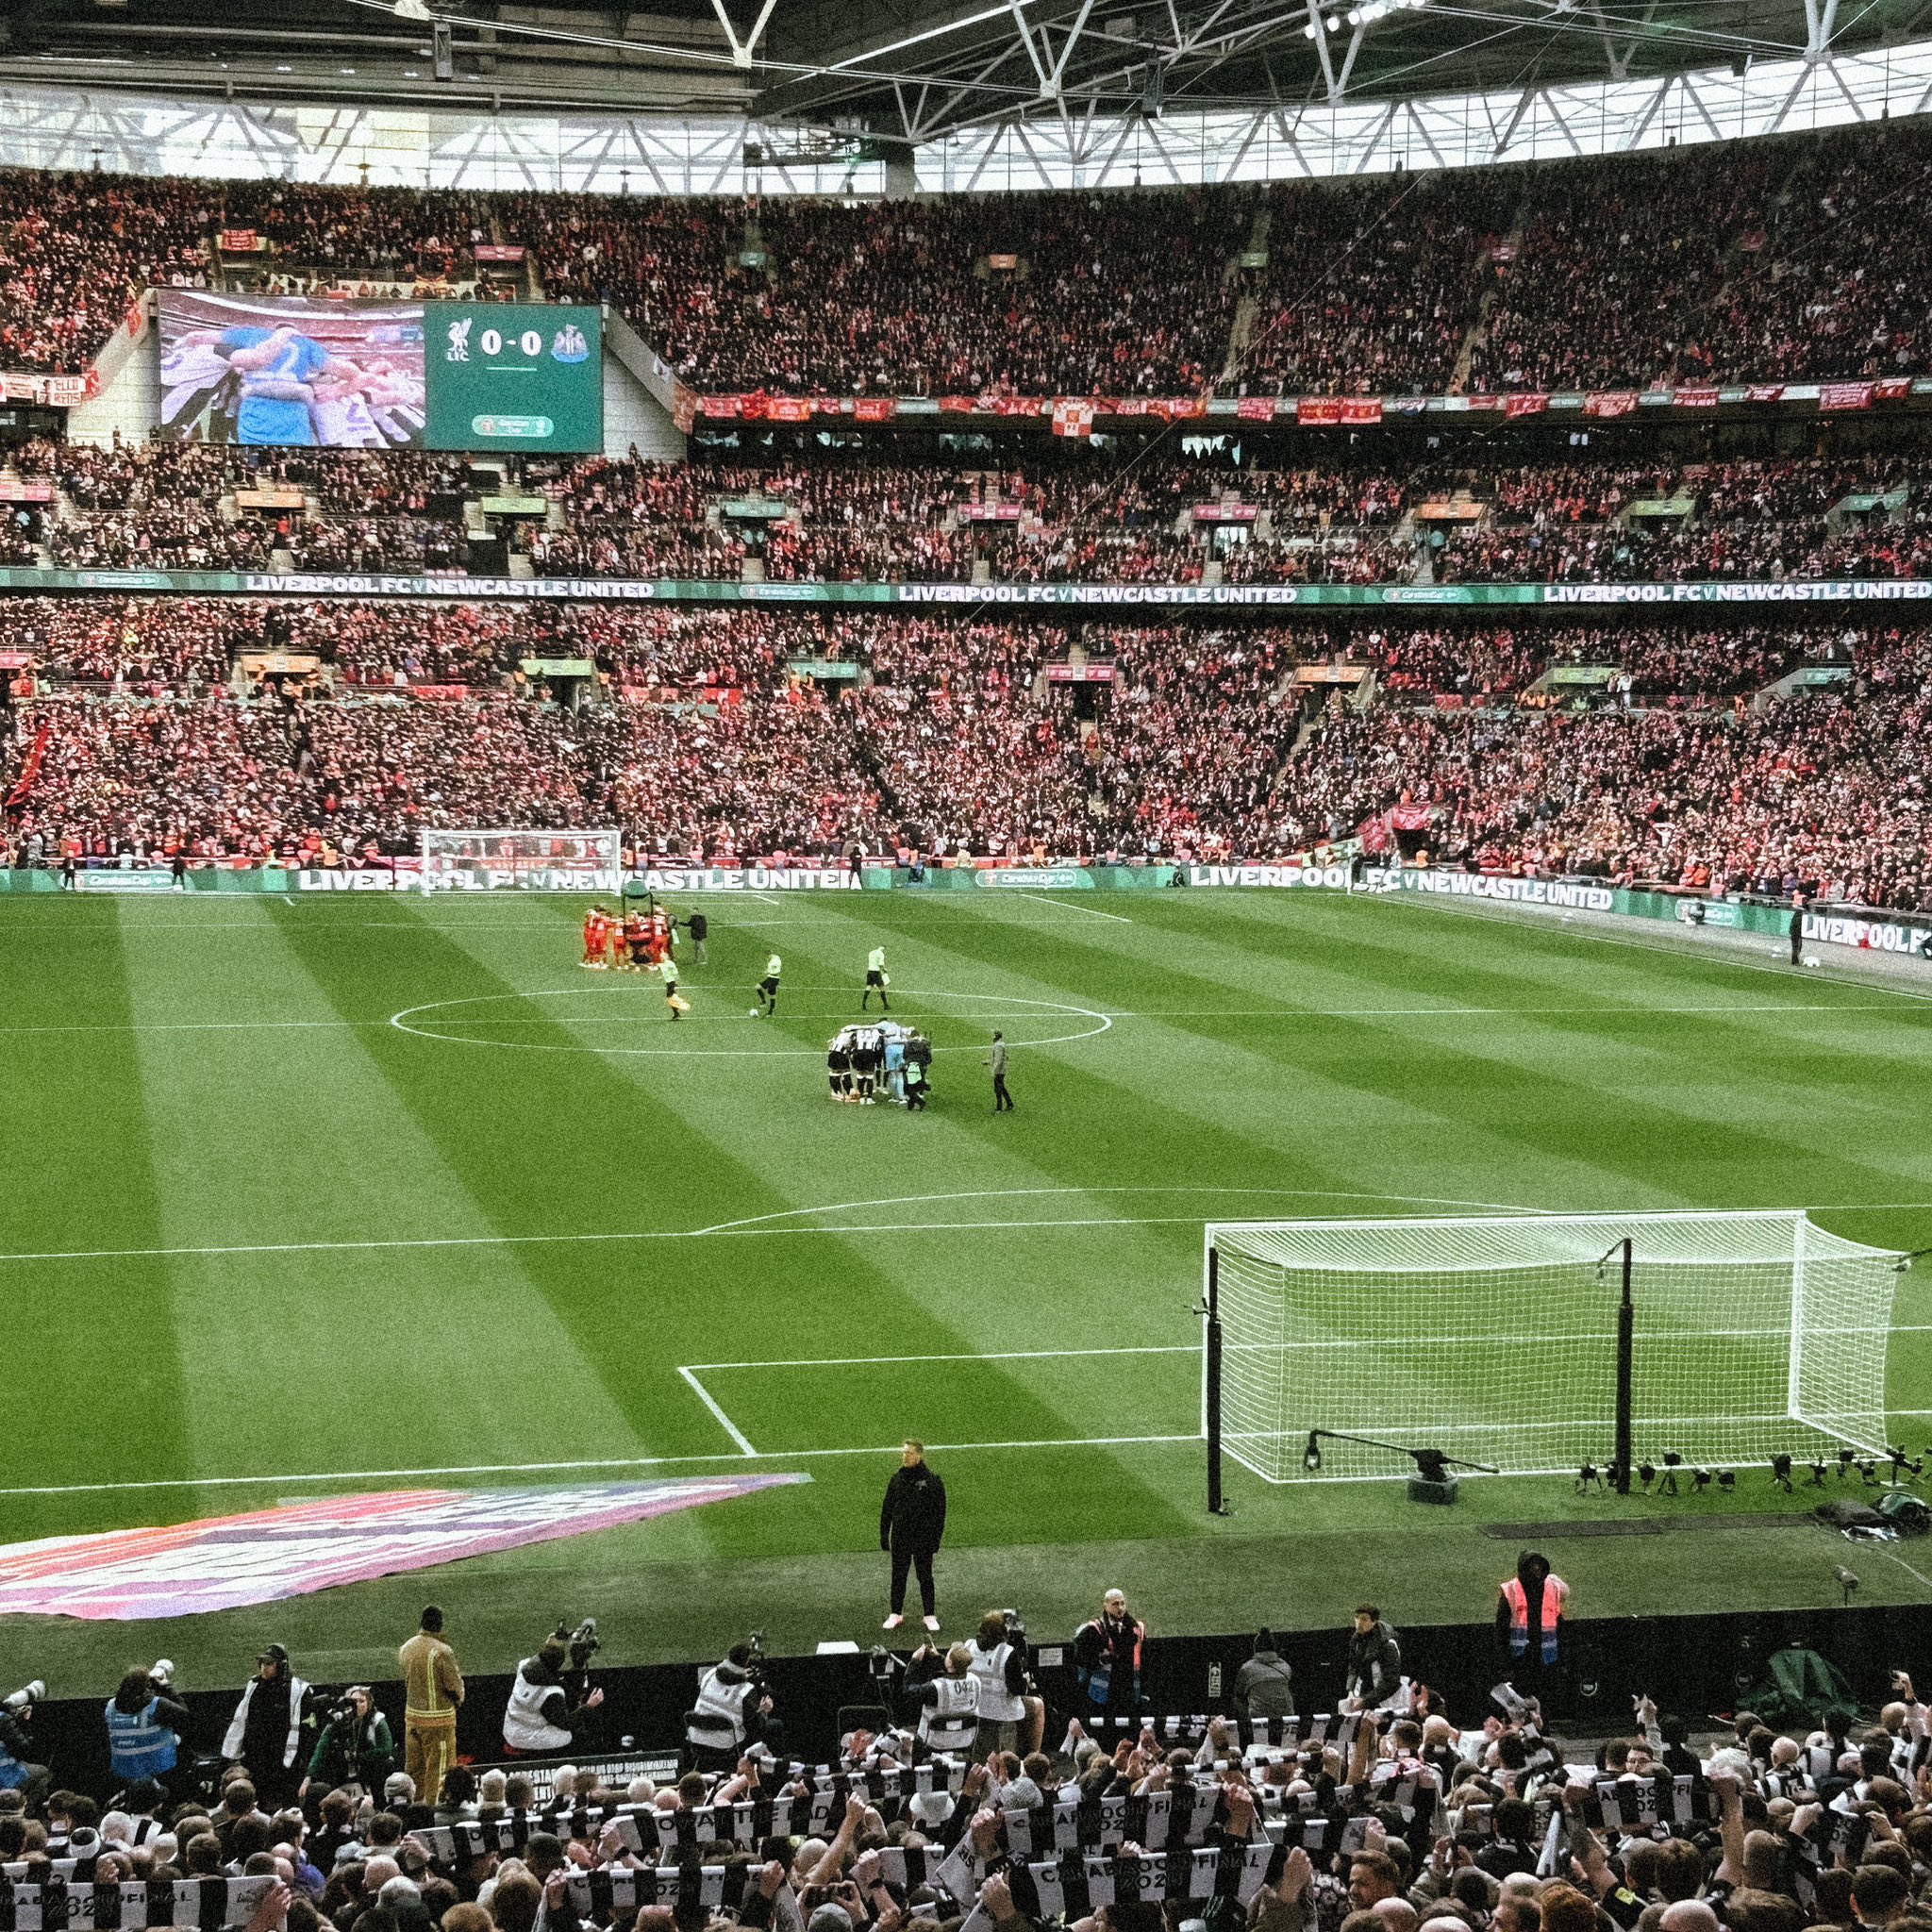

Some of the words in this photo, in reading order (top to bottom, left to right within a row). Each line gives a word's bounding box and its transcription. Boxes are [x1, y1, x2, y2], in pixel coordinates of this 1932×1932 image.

[246, 575, 378, 592] LIVERPOOL
[382, 577, 412, 593] FC
[425, 578, 568, 596] NEWCASTLE
[570, 581, 655, 598] UNITED
[899, 585, 1025, 602] LIVERPOOL
[1028, 587, 1056, 602] FC
[1072, 587, 1211, 603] NEWCASTLE
[1214, 587, 1297, 604] UNITED
[1544, 585, 1671, 602] LIVERPOOL
[1673, 584, 1701, 601] FC
[1716, 582, 1851, 601] NEWCASTLE
[1853, 581, 1931, 599] UNITED
[1191, 866, 1356, 889] LIVERPOOL
[1367, 869, 1401, 891] FC
[1418, 872, 1545, 903] NEWCASTLE
[1547, 882, 1613, 910] UNITED
[1802, 914, 1907, 953] LIVERPOOL
